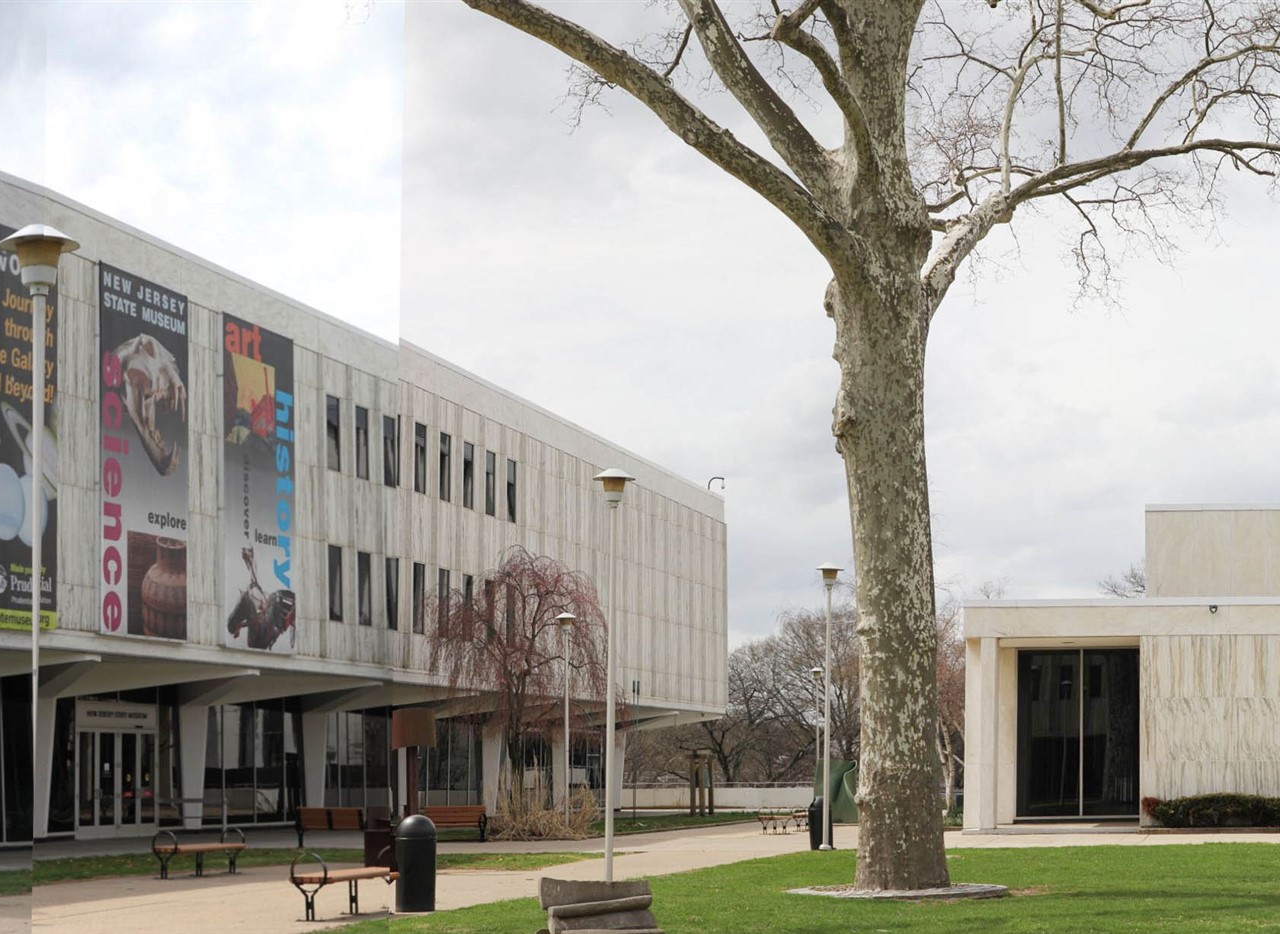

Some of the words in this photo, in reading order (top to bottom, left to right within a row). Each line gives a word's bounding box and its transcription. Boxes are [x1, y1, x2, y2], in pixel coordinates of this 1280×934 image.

[103, 271, 132, 295] NEW
[137, 285, 186, 316] JERSEY
[103, 291, 138, 318] STATE
[142, 306, 186, 336] MUSEUM
[11, 347, 54, 380] Galy
[225, 321, 262, 363] art
[102, 351, 128, 632] science
[273, 389, 294, 590] history
[148, 511, 187, 531] explore
[255, 528, 278, 548] learn
